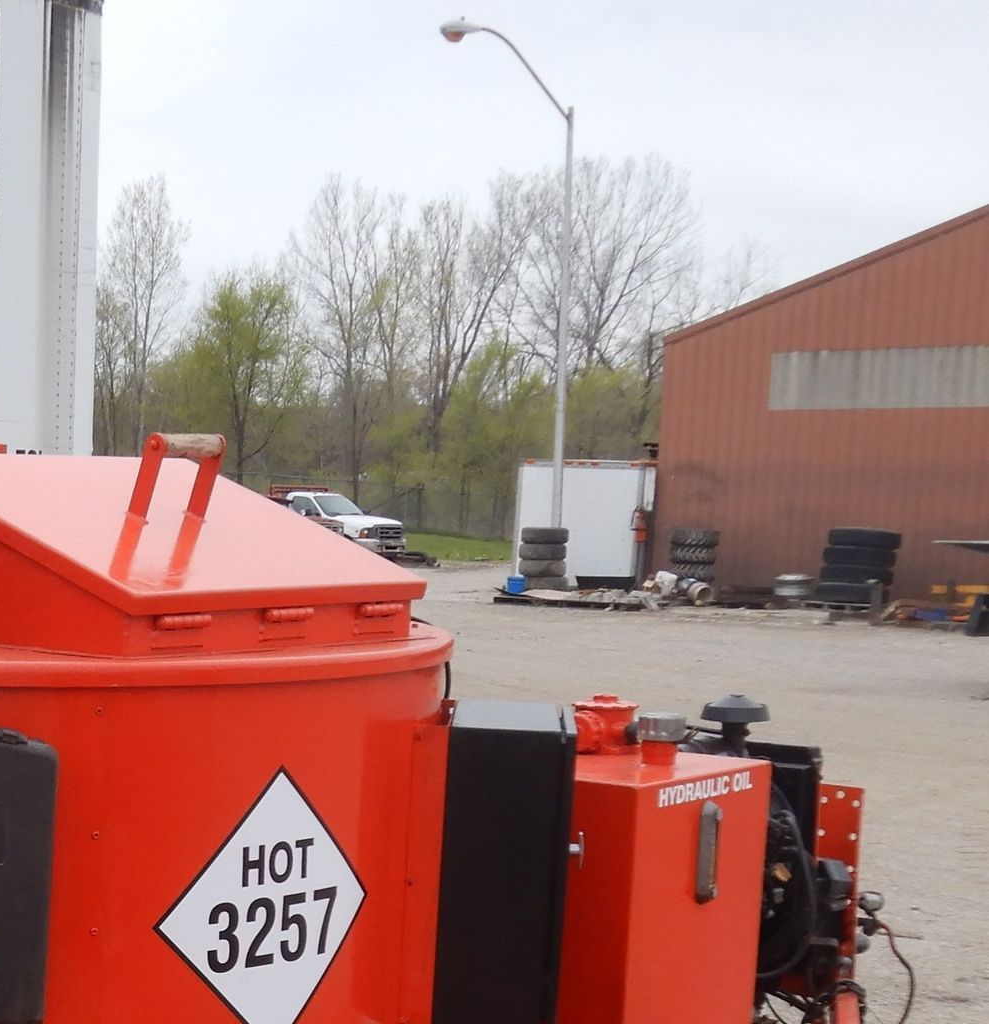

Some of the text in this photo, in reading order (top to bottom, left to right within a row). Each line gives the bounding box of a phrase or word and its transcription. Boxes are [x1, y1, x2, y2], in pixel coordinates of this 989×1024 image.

[658, 771, 753, 808] HYDRAULIC OIL
[241, 838, 315, 888] HOT
[207, 886, 338, 974] 3257
